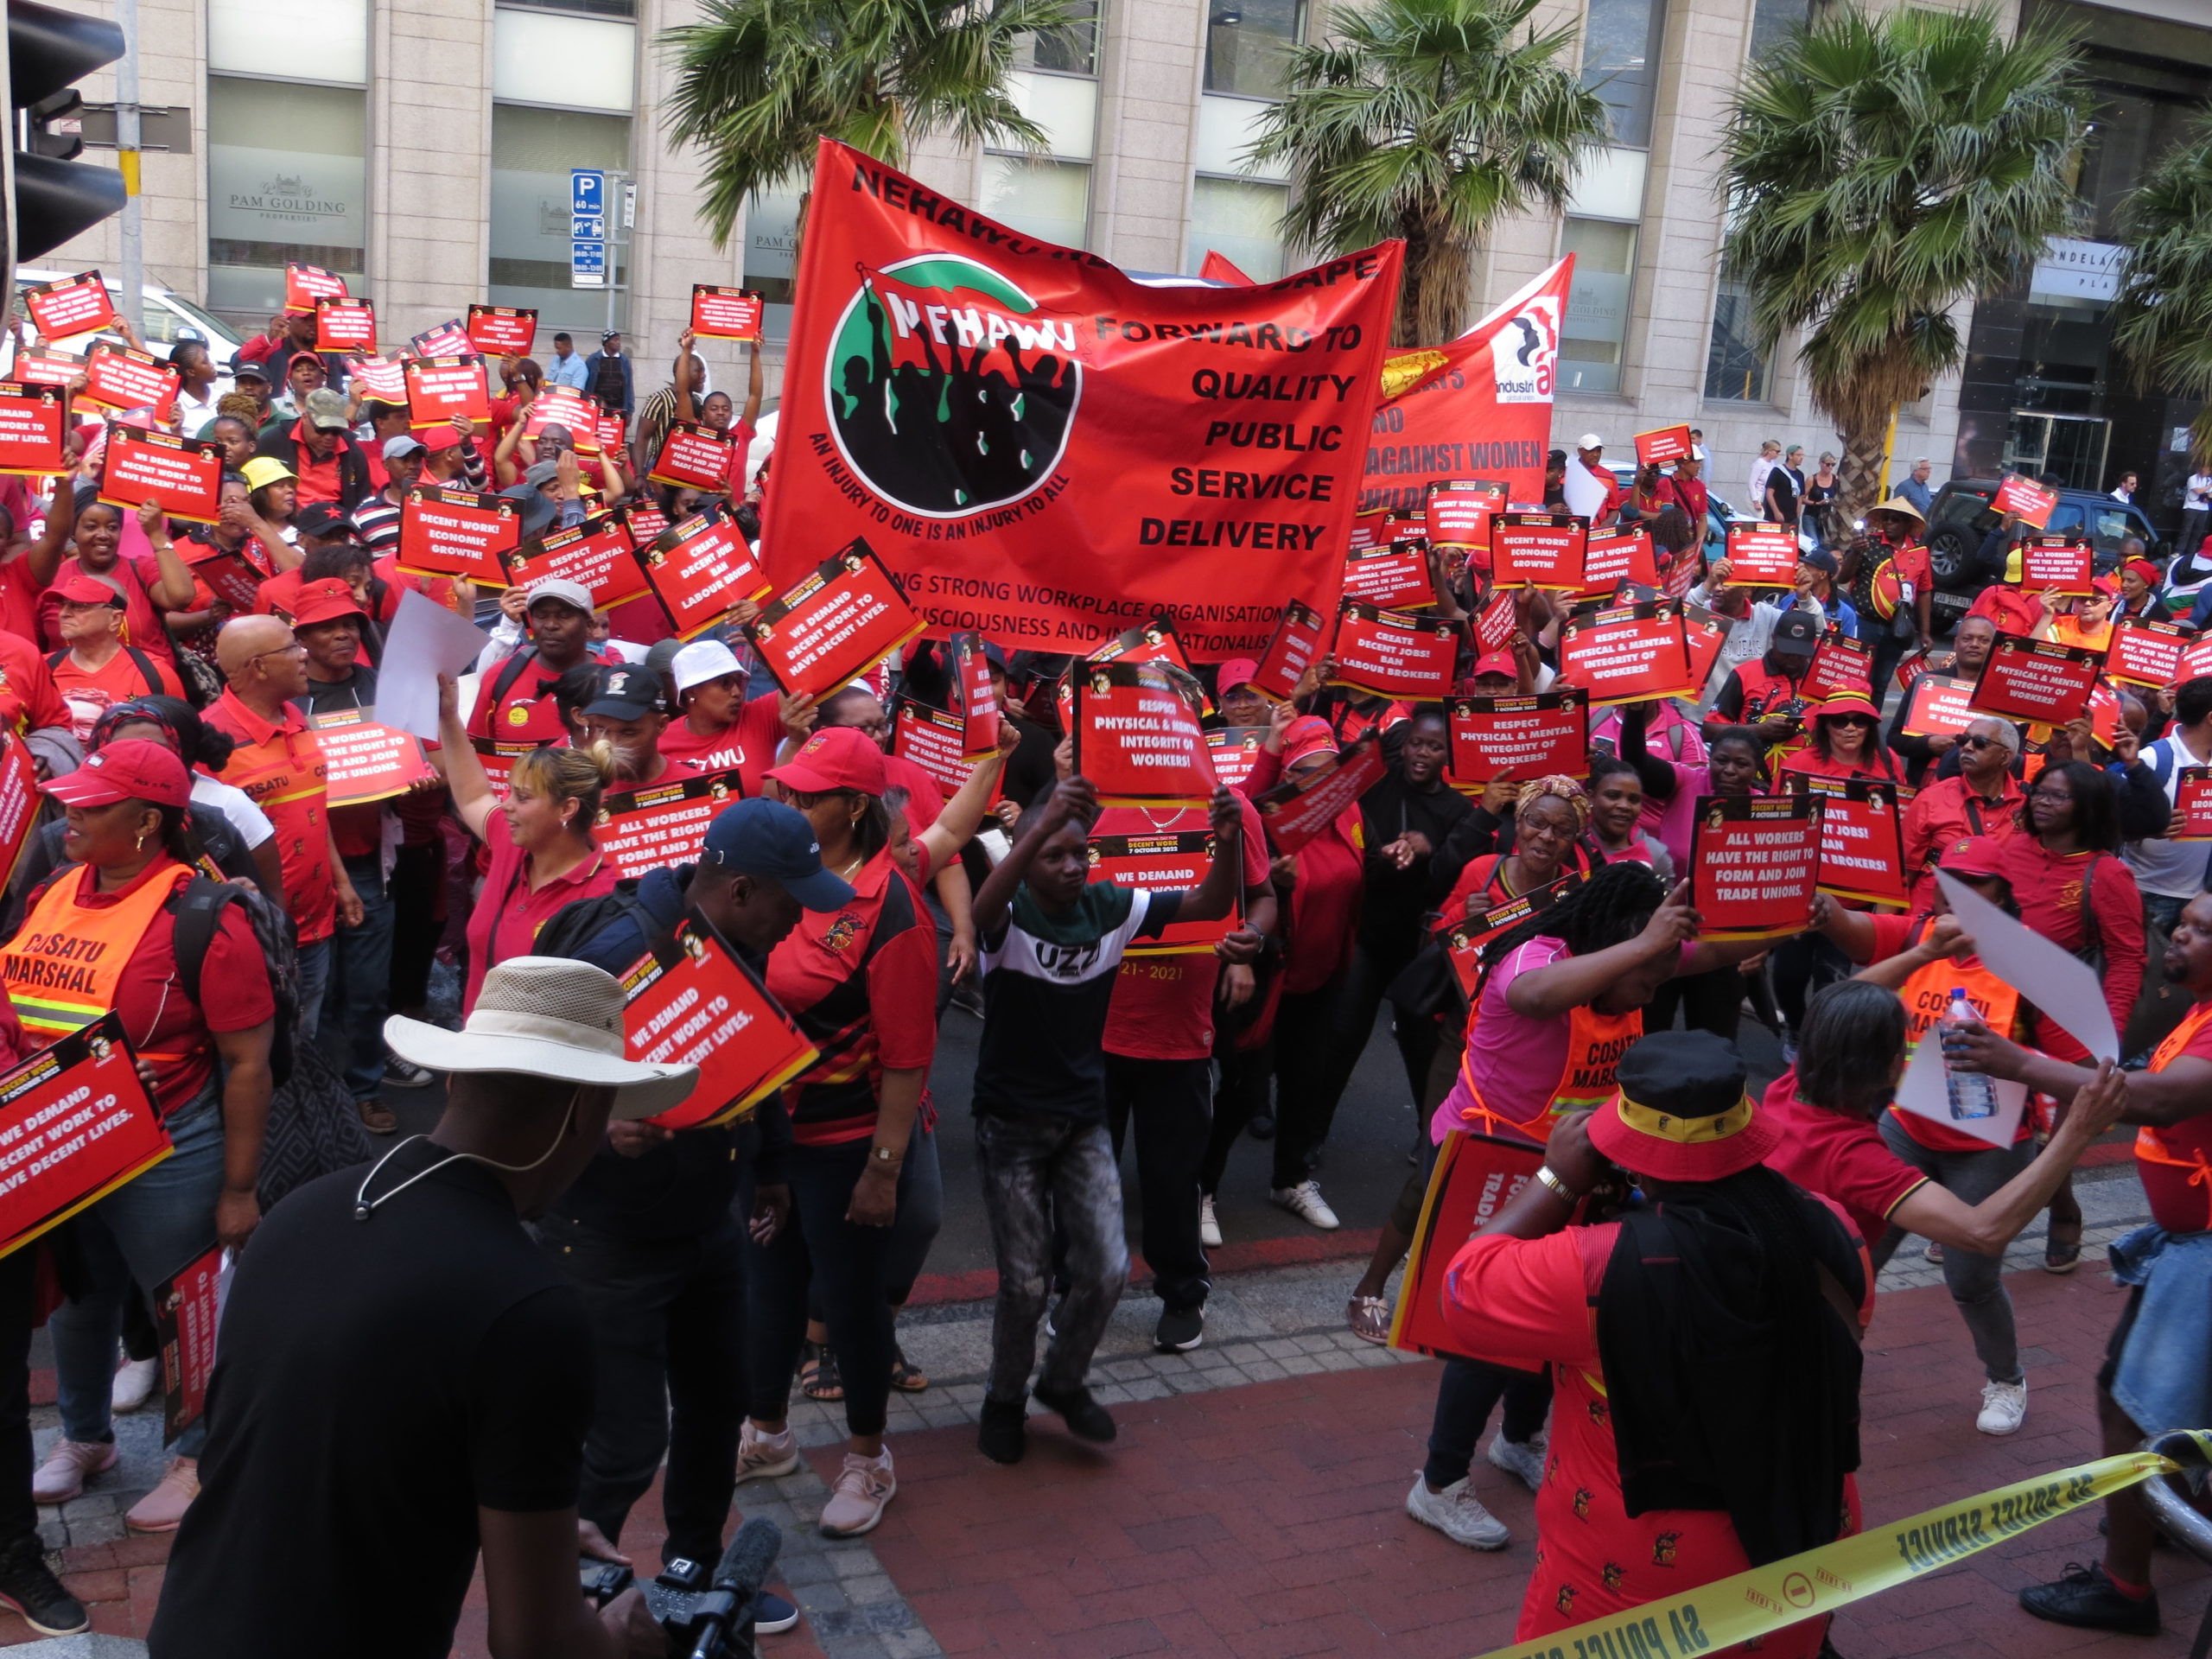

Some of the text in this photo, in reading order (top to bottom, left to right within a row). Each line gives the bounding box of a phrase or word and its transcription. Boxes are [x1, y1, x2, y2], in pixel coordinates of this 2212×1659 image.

[580, 178, 594, 195] P
[230, 194, 346, 213] PAM GOLDING
[575, 200, 587, 209] 60
[851, 163, 1041, 255] NEHAWU
[260, 213, 317, 222] PROPERTIES
[754, 236, 783, 246] PAM
[2059, 251, 2106, 266] NDELA
[2079, 278, 2108, 289] PLA
[885, 291, 1077, 352] NEHAWU
[1095, 315, 1362, 353] FORWARD TO
[97, 364, 171, 391] HAVE THE RIGHT TO
[125, 364, 163, 381] WORKERS
[99, 382, 159, 405] TRADE UNIONS.
[100, 374, 163, 397] FORM AND JOIN
[1192, 369, 1357, 403] QUALITY
[1496, 380, 1535, 394] industri
[1205, 421, 1343, 451] PUBLIC
[134, 452, 191, 470] WE DEMAND
[1365, 442, 1541, 475] AGAINST WOMEN
[115, 470, 207, 494] HAVE DECENT LIVES.
[121, 460, 202, 483] DECENT WORK TO
[809, 432, 1071, 541] AN INJURY TO ONE IS AN INJURY TO ALL
[1170, 467, 1334, 502] SERVICE
[419, 512, 500, 534] DECENT WORK!
[429, 530, 487, 546] ECONOMIC
[1139, 518, 1326, 550] DELIVERY
[1536, 537, 1568, 546] WORK!
[431, 544, 483, 560] GROWTH!
[690, 536, 720, 557] CREATE
[1511, 549, 1558, 557] ECONOMIC
[680, 541, 735, 580] DECENT JOBS!
[710, 561, 729, 578] BAN
[1513, 560, 1554, 569] GROWTH!
[682, 561, 753, 609] LABOUR BROKERS!
[928, 575, 1010, 601] STRONG
[1017, 585, 1142, 618] WORKPLACE
[1149, 601, 1286, 623] ORGANISATION
[789, 591, 852, 639] WE DEMAND
[912, 607, 1099, 642] SCIOUSNESS AND
[786, 594, 873, 660] DECENT WORK TO
[1595, 628, 1638, 643] RESPECT
[789, 602, 889, 676] HAVE DECENT LIVES.
[1357, 639, 1431, 658] DECENT JOBS!
[1376, 632, 1414, 645] CREATE
[1567, 637, 1673, 660] PHYSICAL & MENTAL
[1343, 658, 1440, 679] LABOUR BROKERS!
[1380, 656, 1403, 665] BAN
[1584, 650, 1656, 669] INTEGRITY OF
[2025, 660, 2064, 674] RESPECT
[1592, 663, 1649, 679] WORKERS!
[1994, 664, 2084, 690] PHYSICAL & MENTAL
[2006, 677, 2068, 696] INTEGRITY OF
[2009, 689, 2056, 706] WORKERS!
[1460, 726, 1574, 741] PHYSICAL & MENTAL
[1493, 718, 1541, 730] RESPECT
[1479, 740, 1556, 753] INTEGRITY OF
[1489, 753, 1548, 766] WORKERS!
[242, 775, 289, 796] OSATU
[619, 805, 711, 834] ALL WORKERS
[604, 821, 711, 852] HAVE THE RIGHT
[1726, 830, 1804, 846] ALL WORKERS
[618, 841, 690, 864] FORM AND
[1706, 848, 1814, 864] HAVE THE RIGHT TO
[1115, 868, 1195, 882] WE DEMAND
[1715, 867, 1806, 882] FORM AND JOIN
[1716, 885, 1802, 901] TRADE UNIONS.
[1487, 910, 1510, 923] DECENT
[1510, 902, 1530, 912] WORK
[21, 932, 107, 963] COSATU
[2, 955, 98, 995] MARSHAL
[1149, 966, 1182, 980] 2021
[0, 1085, 92, 1146] WE DEMAND
[45, 1093, 118, 1142] WORK TO
[29, 1110, 135, 1177] DECENT LIVES.
